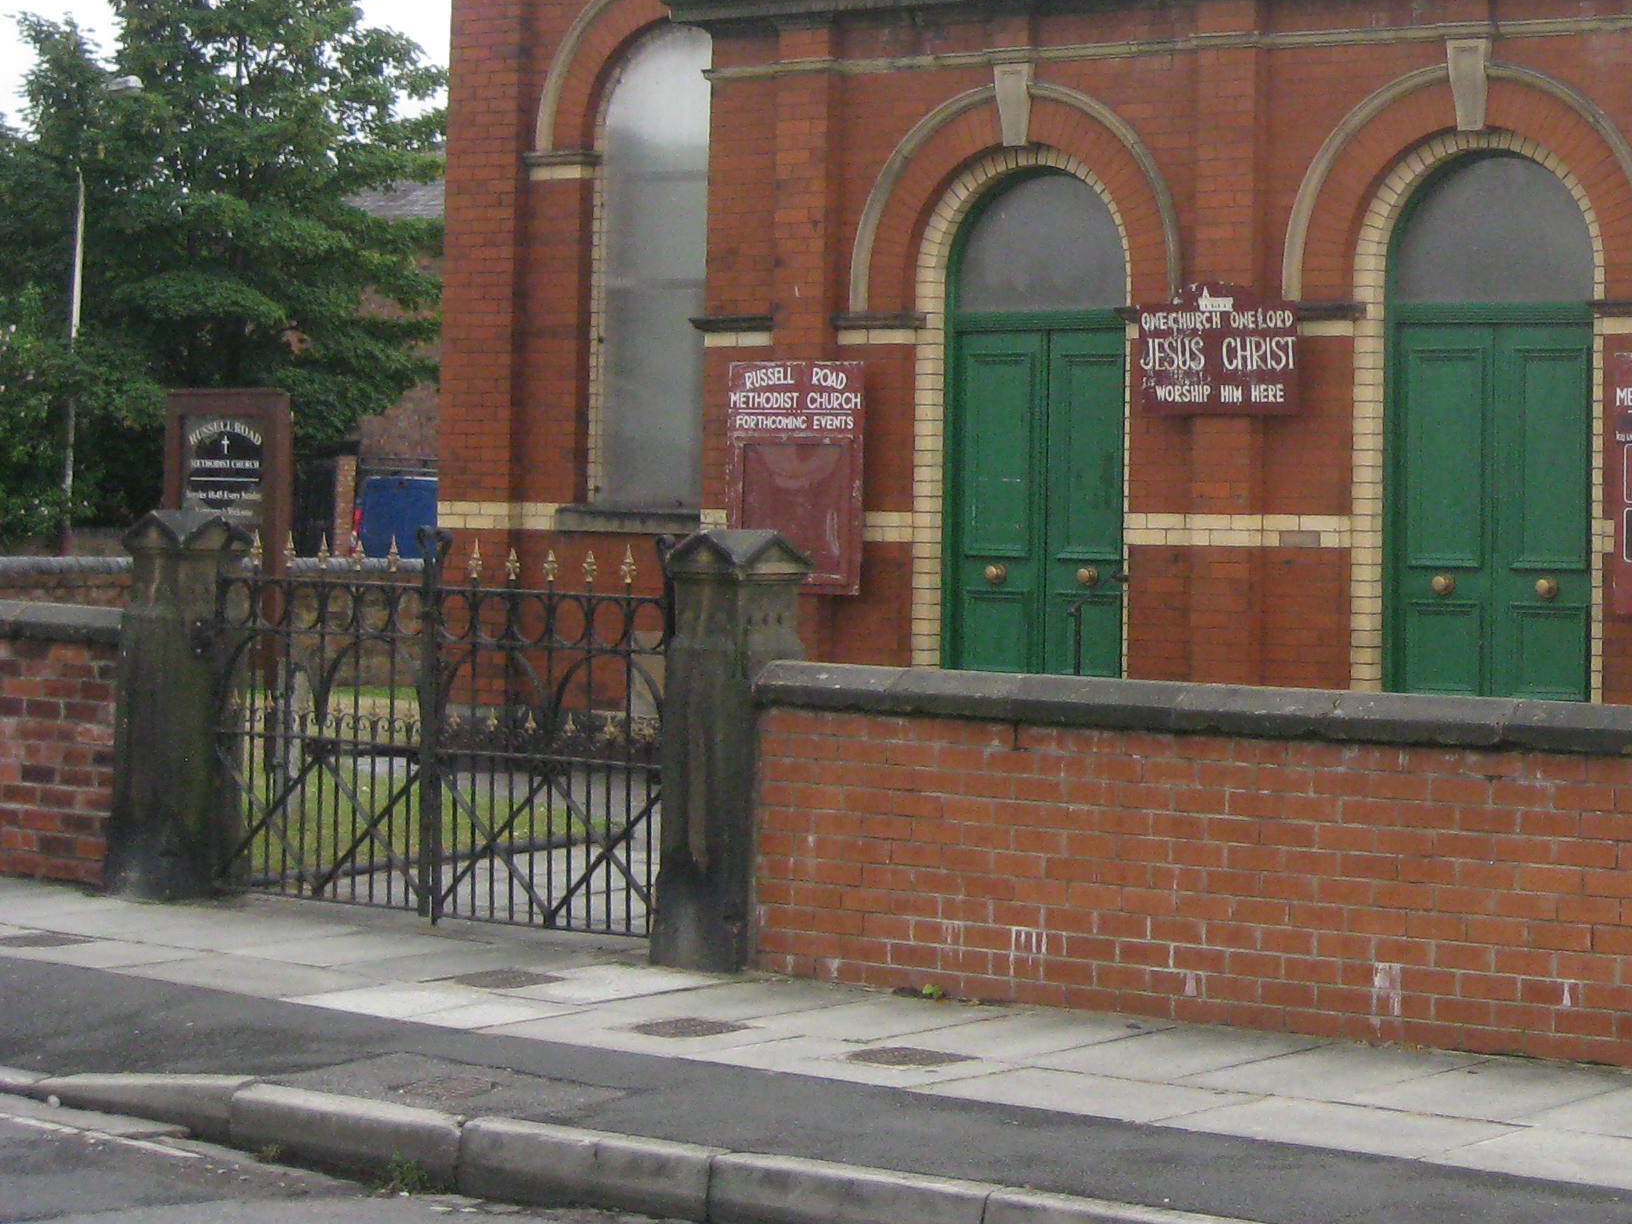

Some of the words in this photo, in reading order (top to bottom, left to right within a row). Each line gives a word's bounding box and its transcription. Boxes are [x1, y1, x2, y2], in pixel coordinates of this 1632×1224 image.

[1230, 311, 1258, 329] ONE
[1258, 310, 1293, 328] LORD
[1140, 337, 1205, 370] JESUS
[1222, 337, 1296, 371] CHRIST
[744, 367, 795, 389] RUSSELL
[811, 367, 847, 390] ROAD
[730, 392, 799, 408] METHODIST
[806, 392, 861, 409] CHURCH
[1155, 385, 1211, 402] WORSHIP
[1220, 386, 1242, 403] HIM
[1251, 384, 1285, 403] HERE
[736, 415, 807, 429] FORTHCOMING
[813, 415, 854, 429] EVENTS
[188, 421, 233, 445] RUSSELL
[234, 422, 262, 445] ROAD
